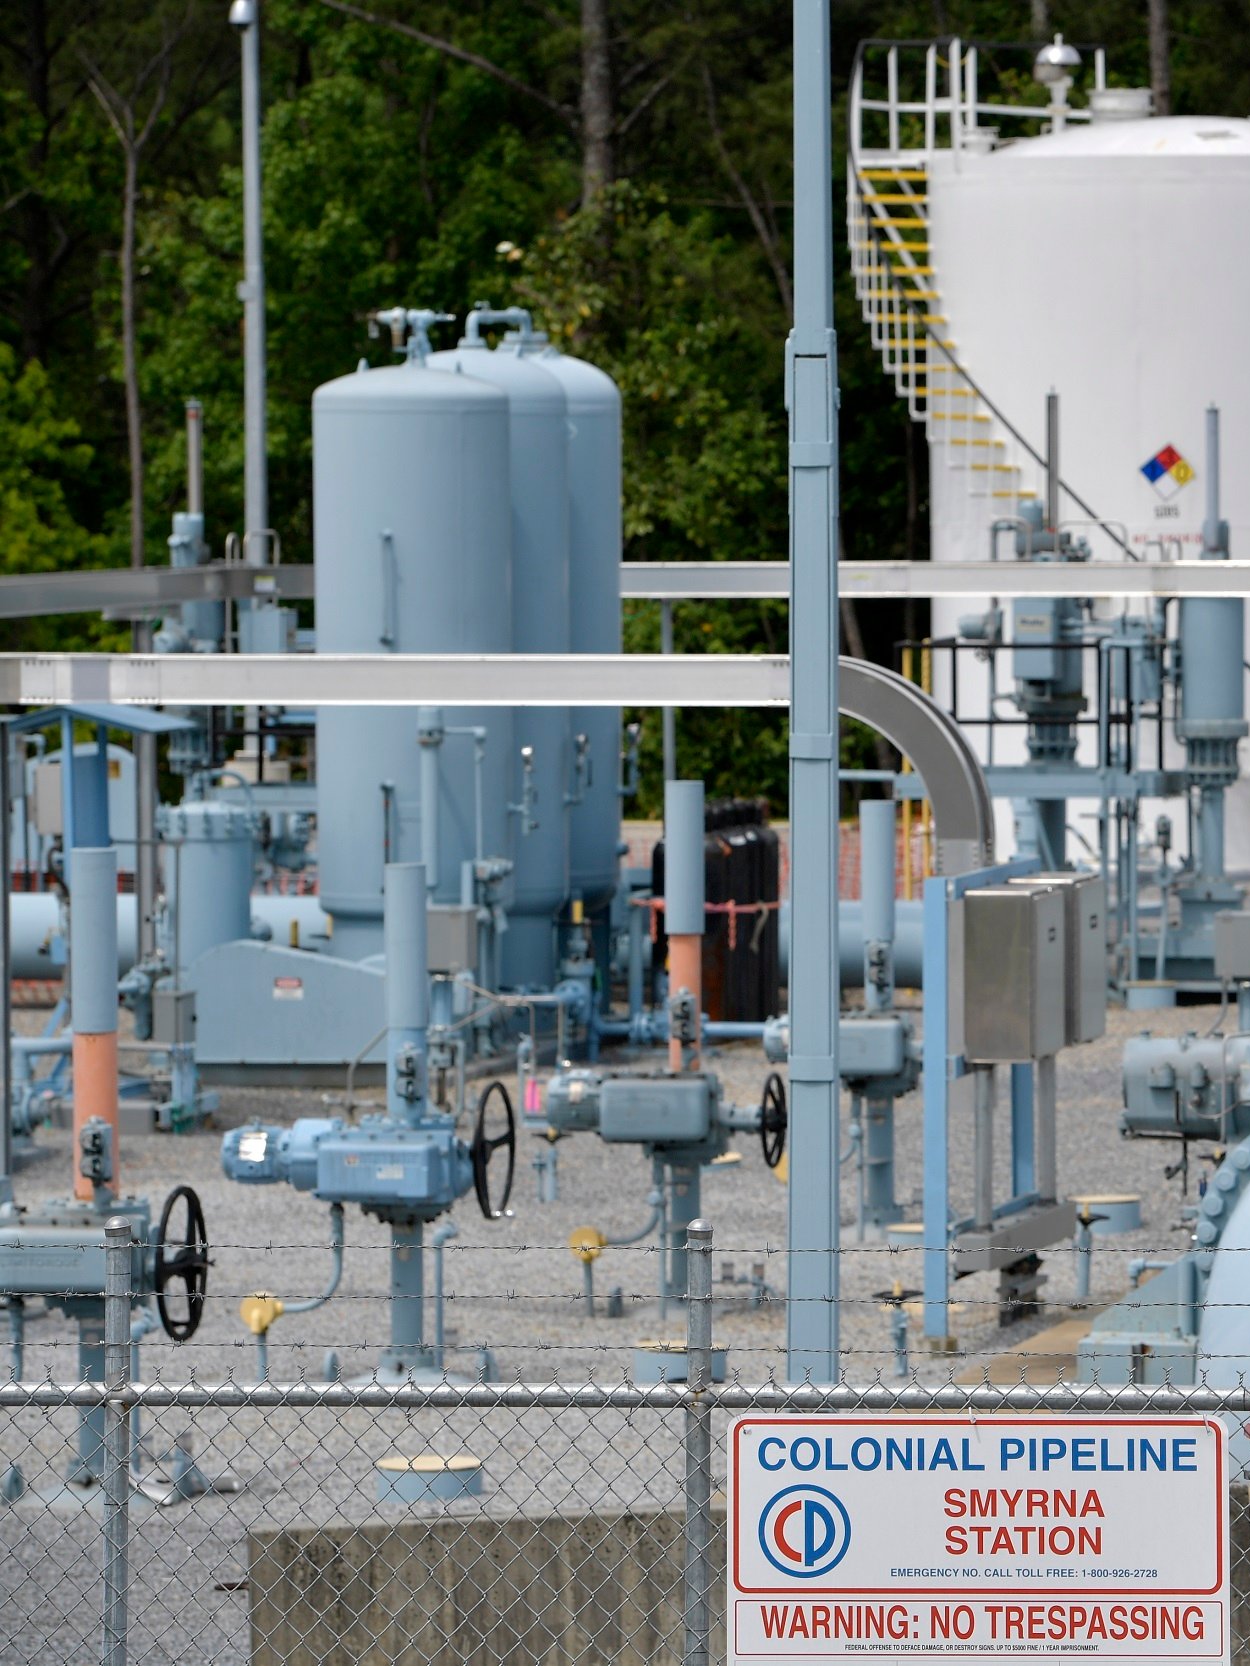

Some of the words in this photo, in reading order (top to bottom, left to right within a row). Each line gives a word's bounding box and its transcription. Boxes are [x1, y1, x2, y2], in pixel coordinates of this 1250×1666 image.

[758, 1437, 985, 1472] COLONIAL
[1001, 1438, 1198, 1472] PIPELINE
[943, 1489, 1105, 1518] SMYRNA
[945, 1526, 1102, 1556] STATION
[890, 1568, 960, 1578] EMERGENCY
[962, 1568, 981, 1578] NO.
[984, 1568, 1012, 1578] CALL
[1015, 1568, 1043, 1578] TOLL
[1046, 1568, 1079, 1578] FREE:
[1081, 1568, 1158, 1578] 1-800-926-2728
[761, 1604, 919, 1640] WARNING:
[930, 1605, 975, 1640] NO
[985, 1605, 1204, 1641] TRESPASSING
